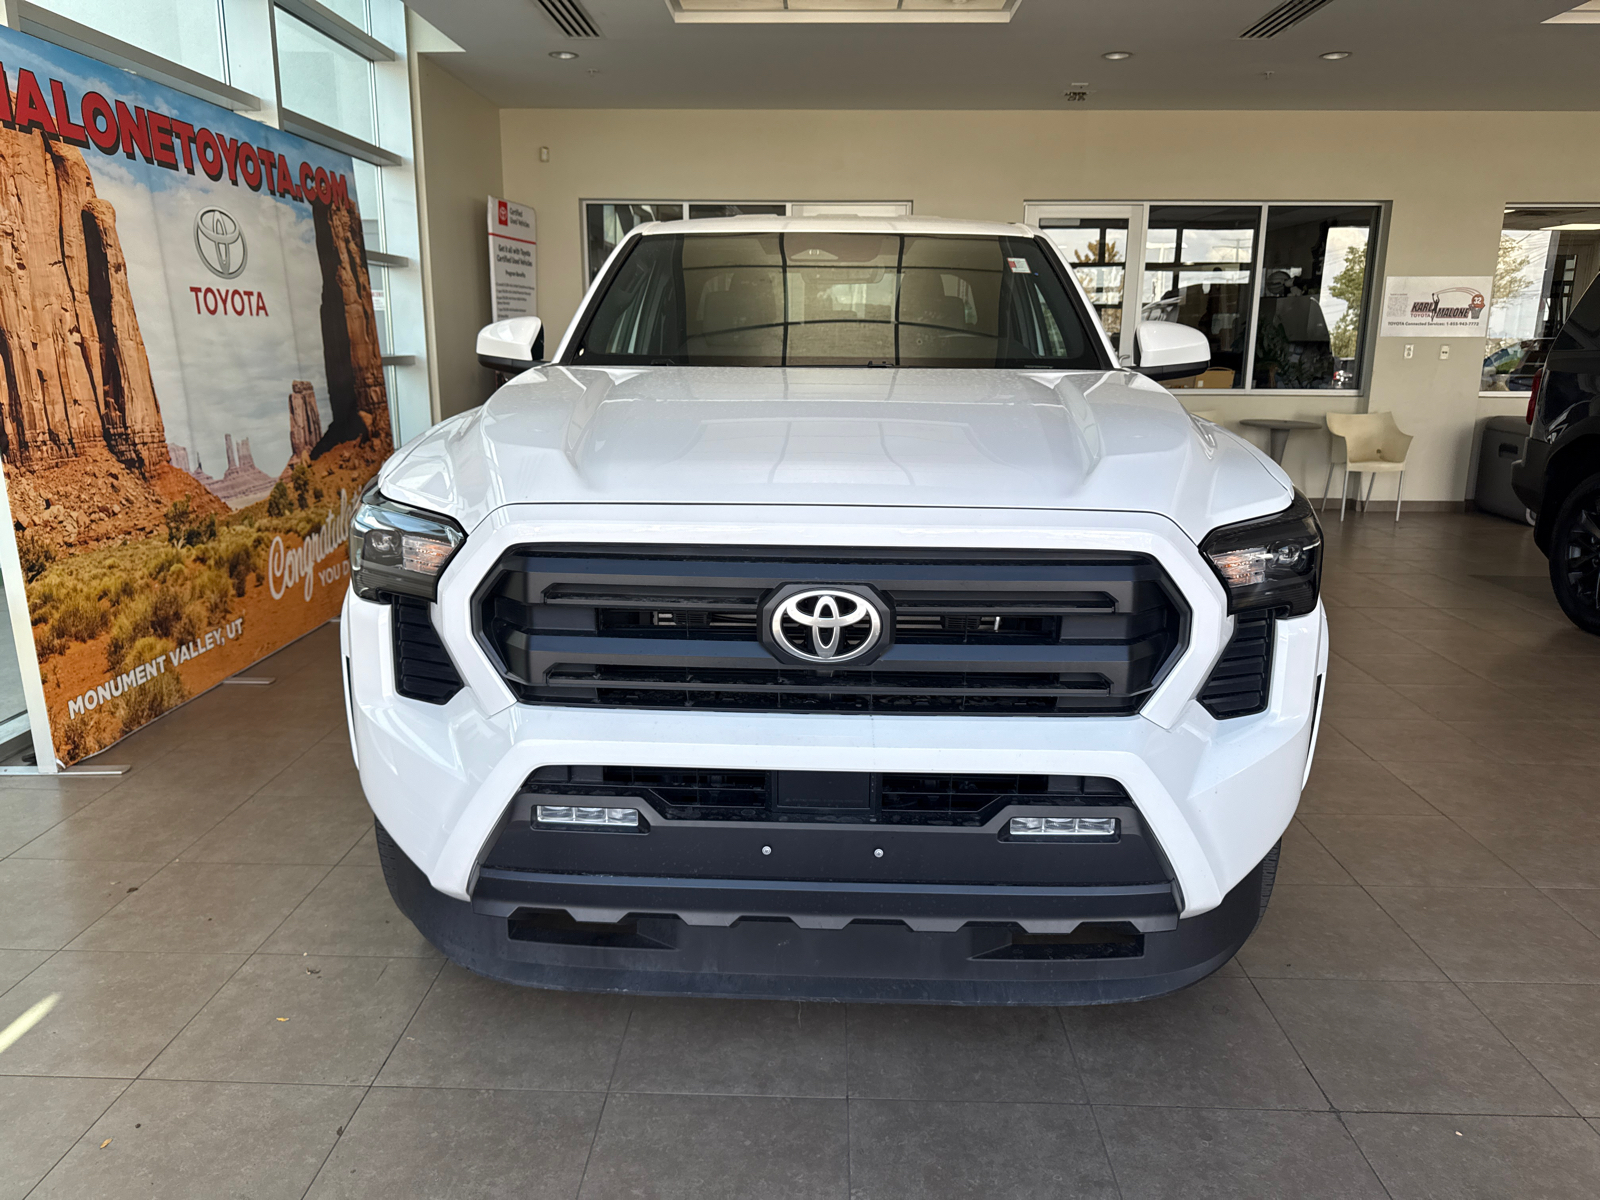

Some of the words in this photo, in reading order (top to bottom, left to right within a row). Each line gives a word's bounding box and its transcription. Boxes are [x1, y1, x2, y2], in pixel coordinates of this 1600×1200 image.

[190, 286, 269, 318] TOYOTA
[1411, 302, 1433, 312] KARL
[1437, 307, 1469, 318] MALONE
[1474, 297, 1482, 305] 32
[318, 563, 341, 586] YOU
[342, 560, 350, 576] D
[67, 655, 167, 720] MONUMENT
[168, 627, 226, 668] VALLEY,
[226, 618, 244, 642] UT
